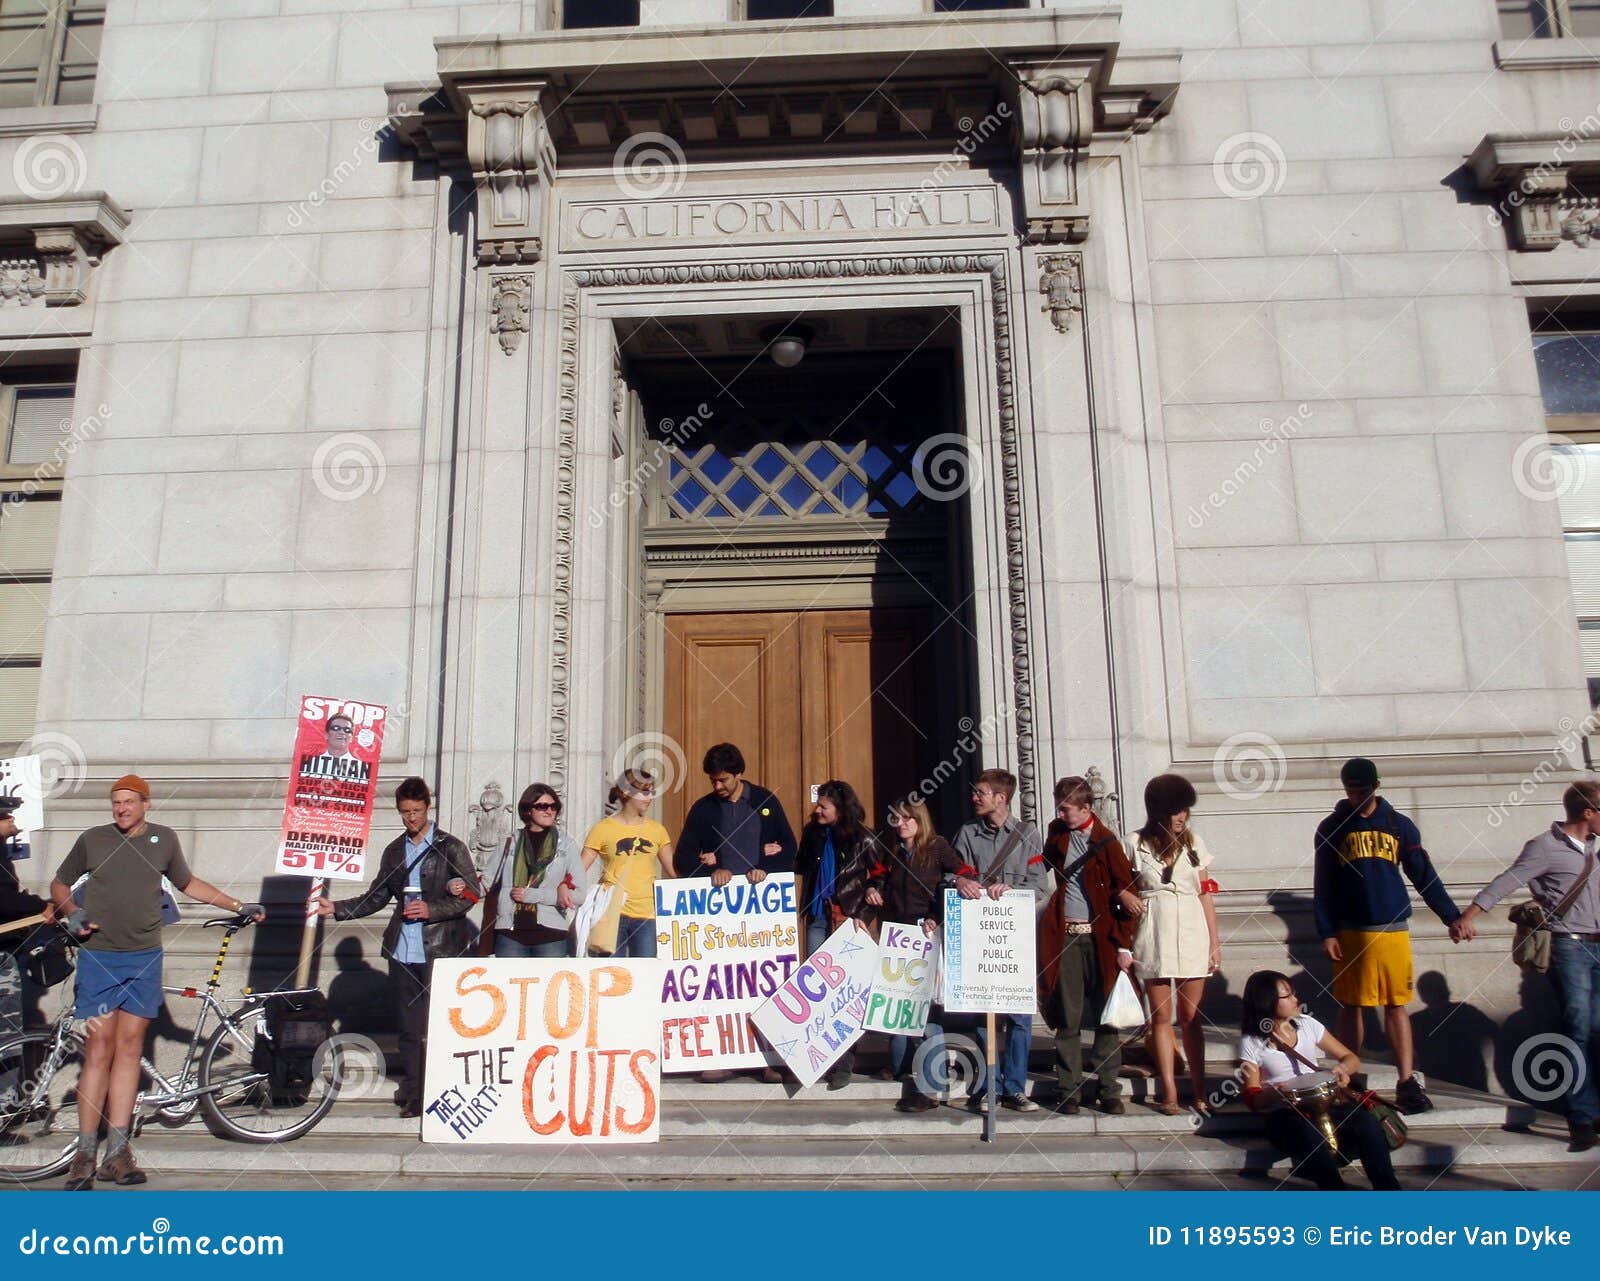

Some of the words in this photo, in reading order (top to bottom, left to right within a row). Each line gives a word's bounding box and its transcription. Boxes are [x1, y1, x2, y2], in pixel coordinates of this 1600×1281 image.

[576, 199, 855, 239] CALIFORNIA
[872, 190, 991, 230] HALL
[303, 697, 385, 728] STOP
[300, 754, 372, 780] HITMAN
[285, 841, 336, 853] MAJORITY
[338, 846, 362, 855] RULE
[287, 830, 364, 848] DEMAND
[283, 850, 360, 874] 51%
[656, 882, 796, 916] LANGUAGE
[982, 906, 1013, 916] PUBLIC
[979, 921, 1016, 932] SERVICE,
[988, 935, 1008, 944] NOT
[978, 964, 1019, 973] PLUNDER
[982, 950, 1013, 959] PUBLIC
[661, 953, 797, 1003] AGAINST
[882, 957, 929, 986] UC
[773, 951, 846, 1024] UCB
[953, 984, 988, 994] University
[991, 985, 1033, 993] Professional
[996, 993, 1033, 1001] Employees
[448, 966, 633, 1048] STOP
[866, 992, 930, 1029] PUBLIC
[663, 1015, 713, 1060] FEE
[807, 1045, 828, 1072] A
[822, 1019, 855, 1051] LA
[425, 1085, 467, 1124] THEY
[453, 1046, 515, 1084] THE
[522, 1045, 657, 1137] CUTS
[450, 1084, 503, 1140] HURT!
